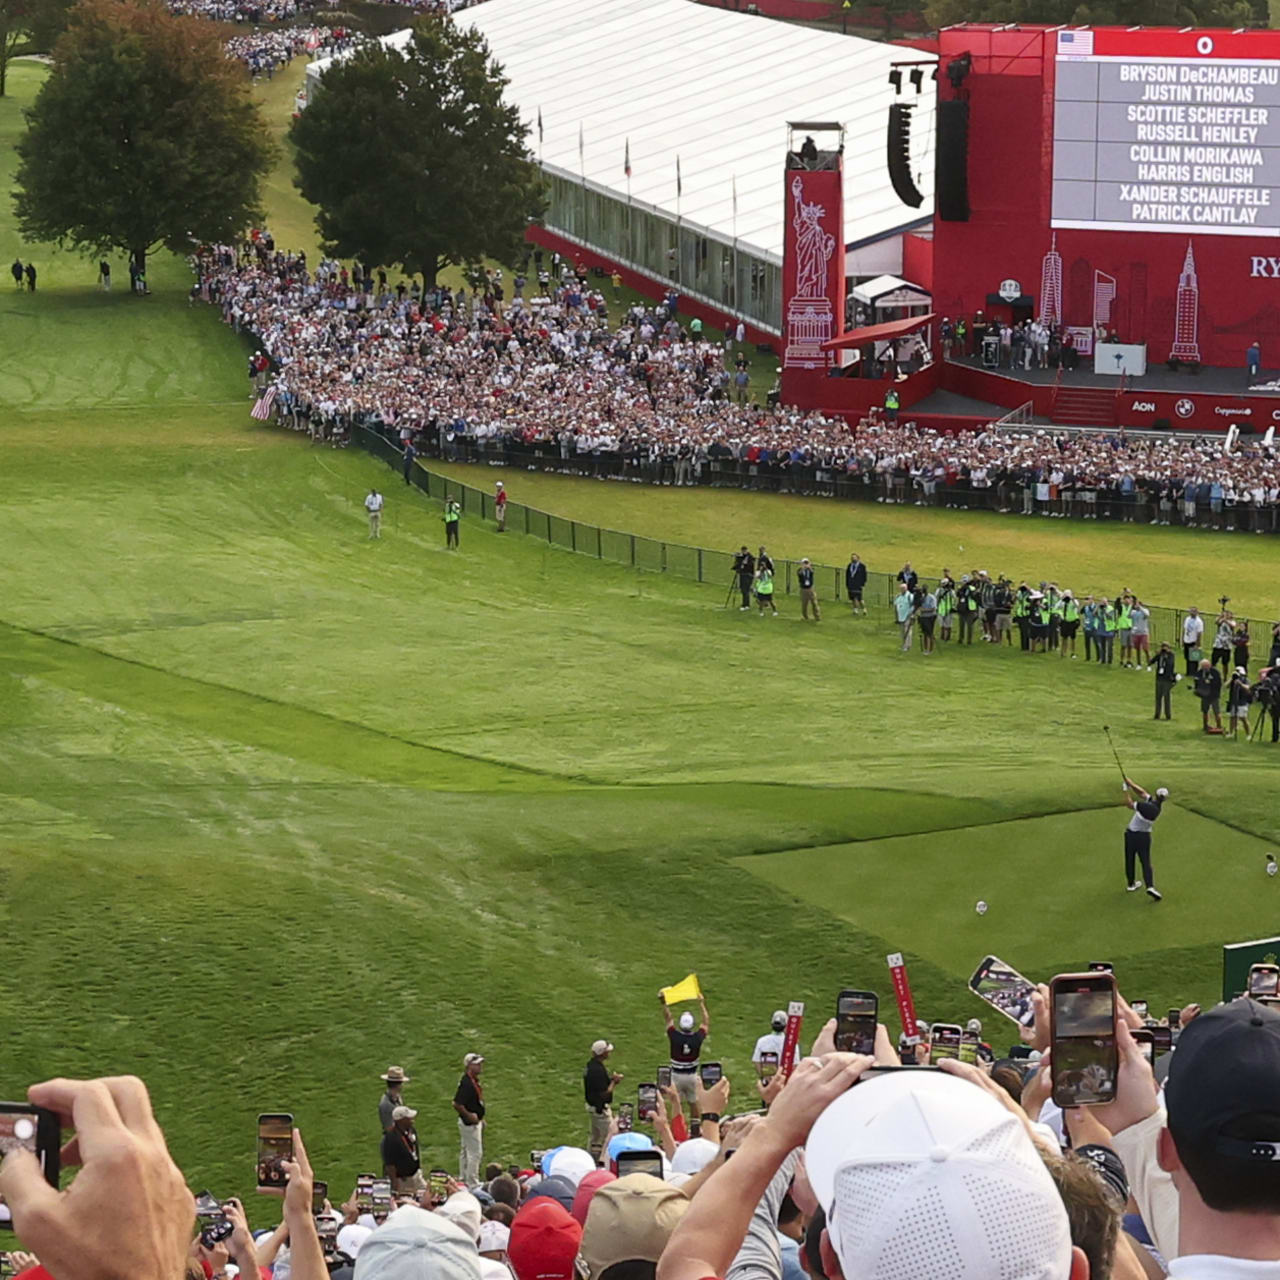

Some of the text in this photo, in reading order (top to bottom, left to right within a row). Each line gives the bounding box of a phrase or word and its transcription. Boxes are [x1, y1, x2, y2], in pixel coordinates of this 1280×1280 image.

[1197, 37, 1213, 54] 0
[1120, 65, 1278, 87] BRYSON DeCHAMBEAU
[1141, 85, 1254, 103] JUSTIN THOMAS
[1127, 105, 1268, 124] SCOTTIE SCHEFFLER
[1137, 124, 1258, 143] RUSSELL HENLEY
[1130, 145, 1264, 166] COLLIN MORIKAWA
[1138, 164, 1254, 183] HARRIS ENGLISH
[1119, 185, 1271, 207] XANDER SCHAUFFELE
[1132, 204, 1258, 223] PATRICK CANTLAY
[1132, 401, 1155, 412] AON
[787, 1017, 797, 1045] QUIET
